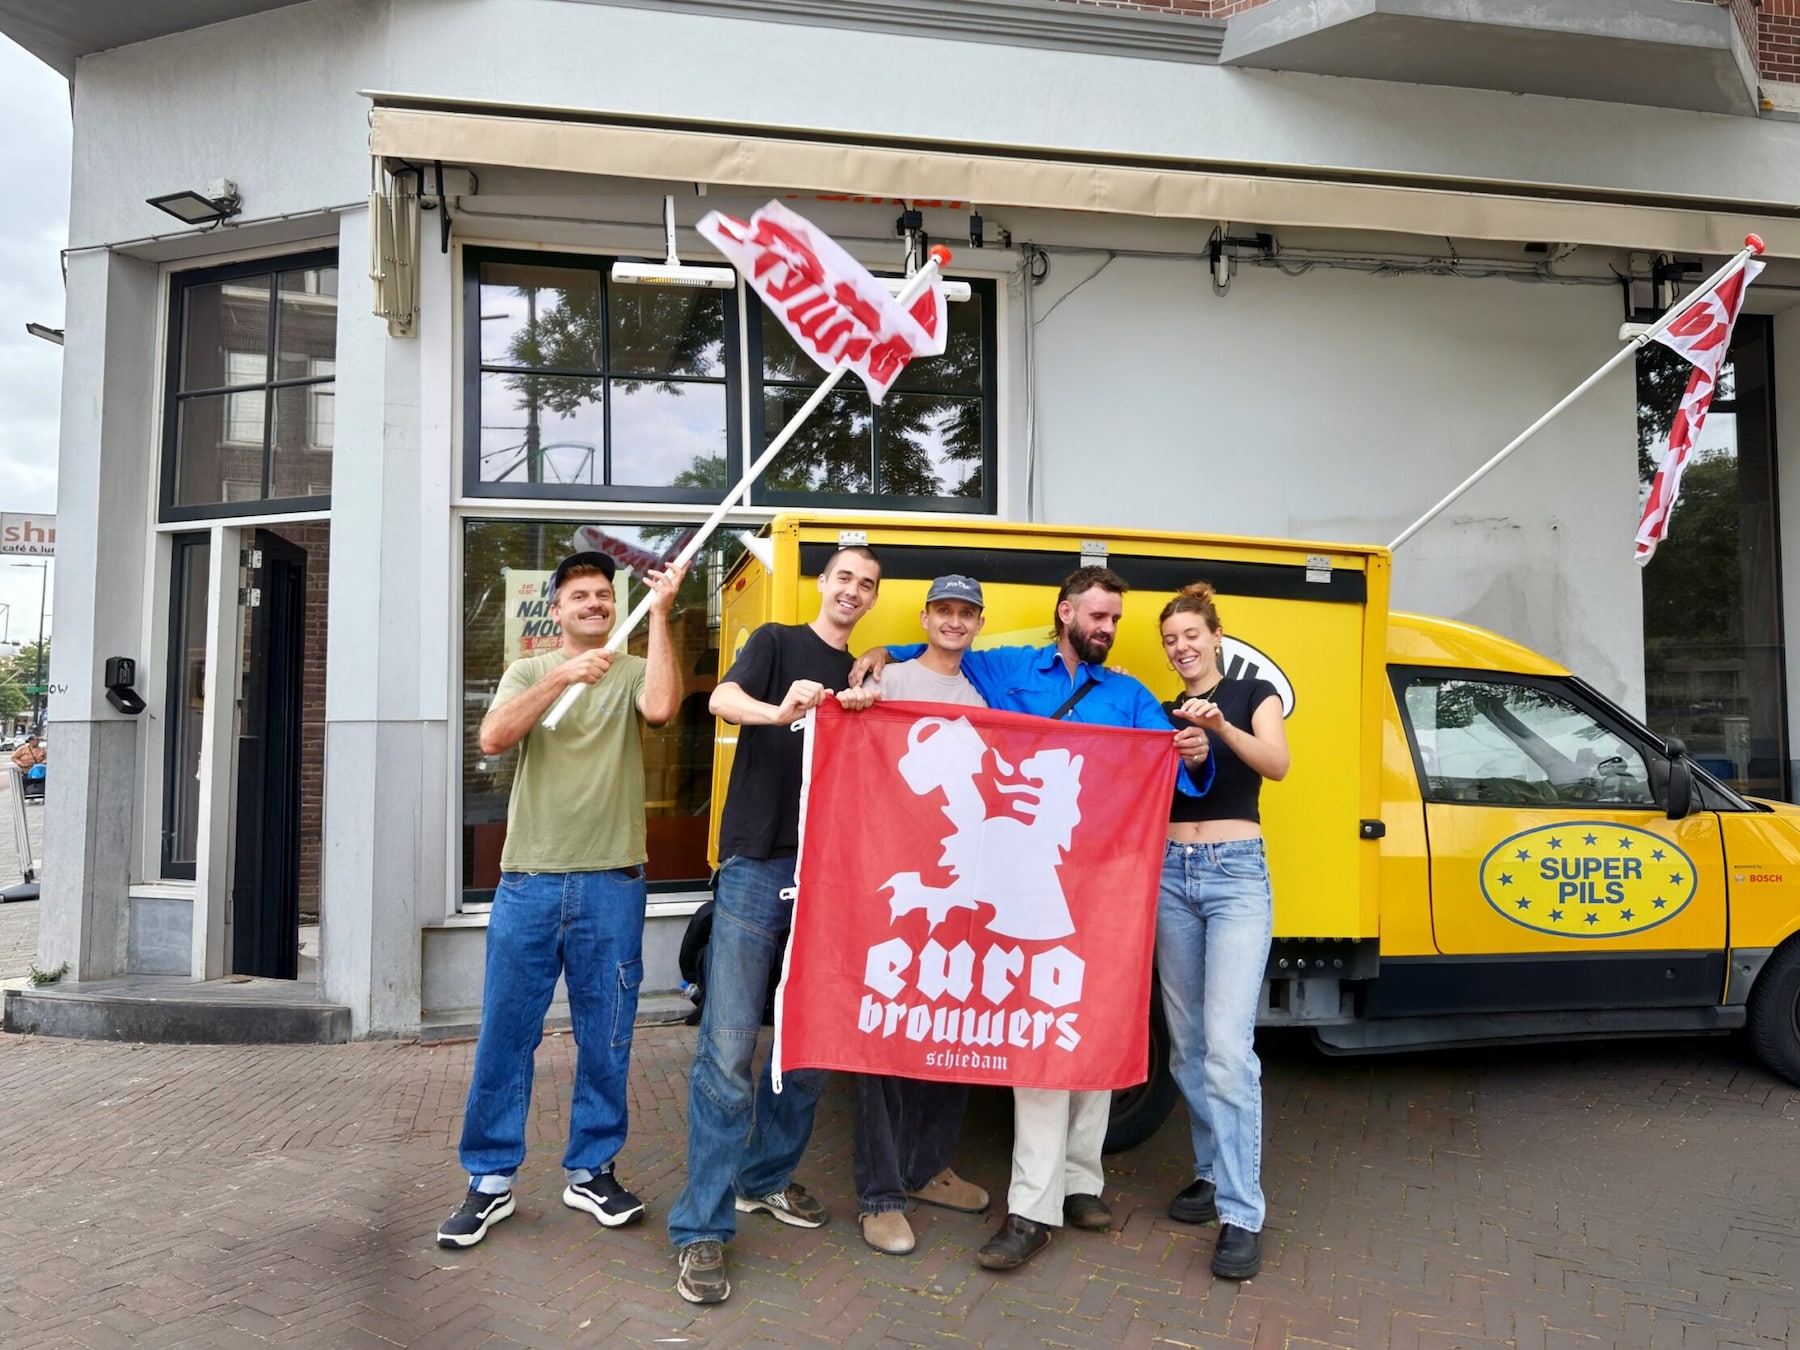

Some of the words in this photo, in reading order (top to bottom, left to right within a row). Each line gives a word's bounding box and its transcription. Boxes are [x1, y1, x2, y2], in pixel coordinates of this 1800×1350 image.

[2, 544, 26, 552] café
[29, 545, 38, 553] &
[1540, 857, 1643, 880] SUPER
[1749, 874, 1783, 883] BOSCH
[1558, 881, 1625, 904] PILS
[864, 937, 1086, 1009] euro
[857, 993, 1082, 1053] brouwers
[925, 1048, 1008, 1071] schiedam
